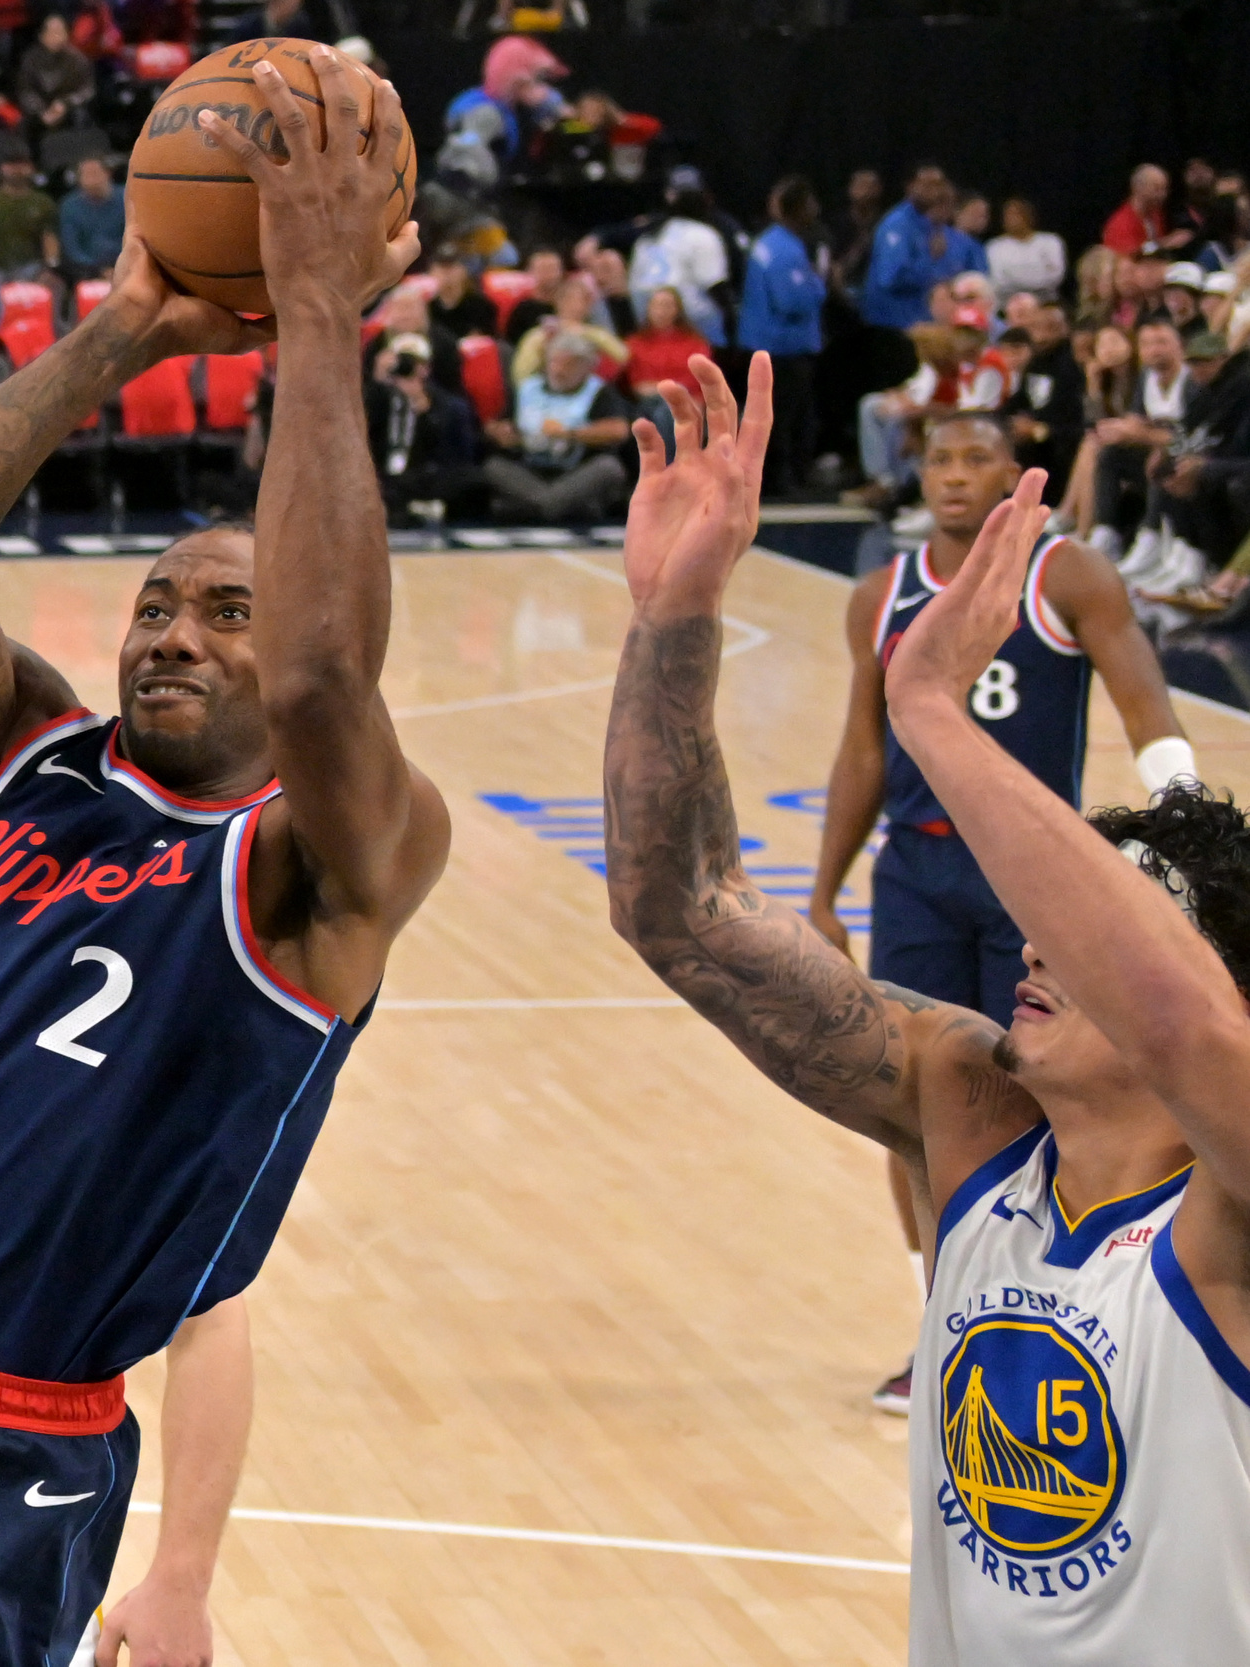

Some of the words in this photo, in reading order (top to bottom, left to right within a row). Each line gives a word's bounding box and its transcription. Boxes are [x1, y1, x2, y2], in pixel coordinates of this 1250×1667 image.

[971, 659, 1019, 720] 8
[36, 945, 133, 1067] 2
[1035, 1379, 1088, 1446] 15
[937, 1479, 1132, 1597] WARRIORS
